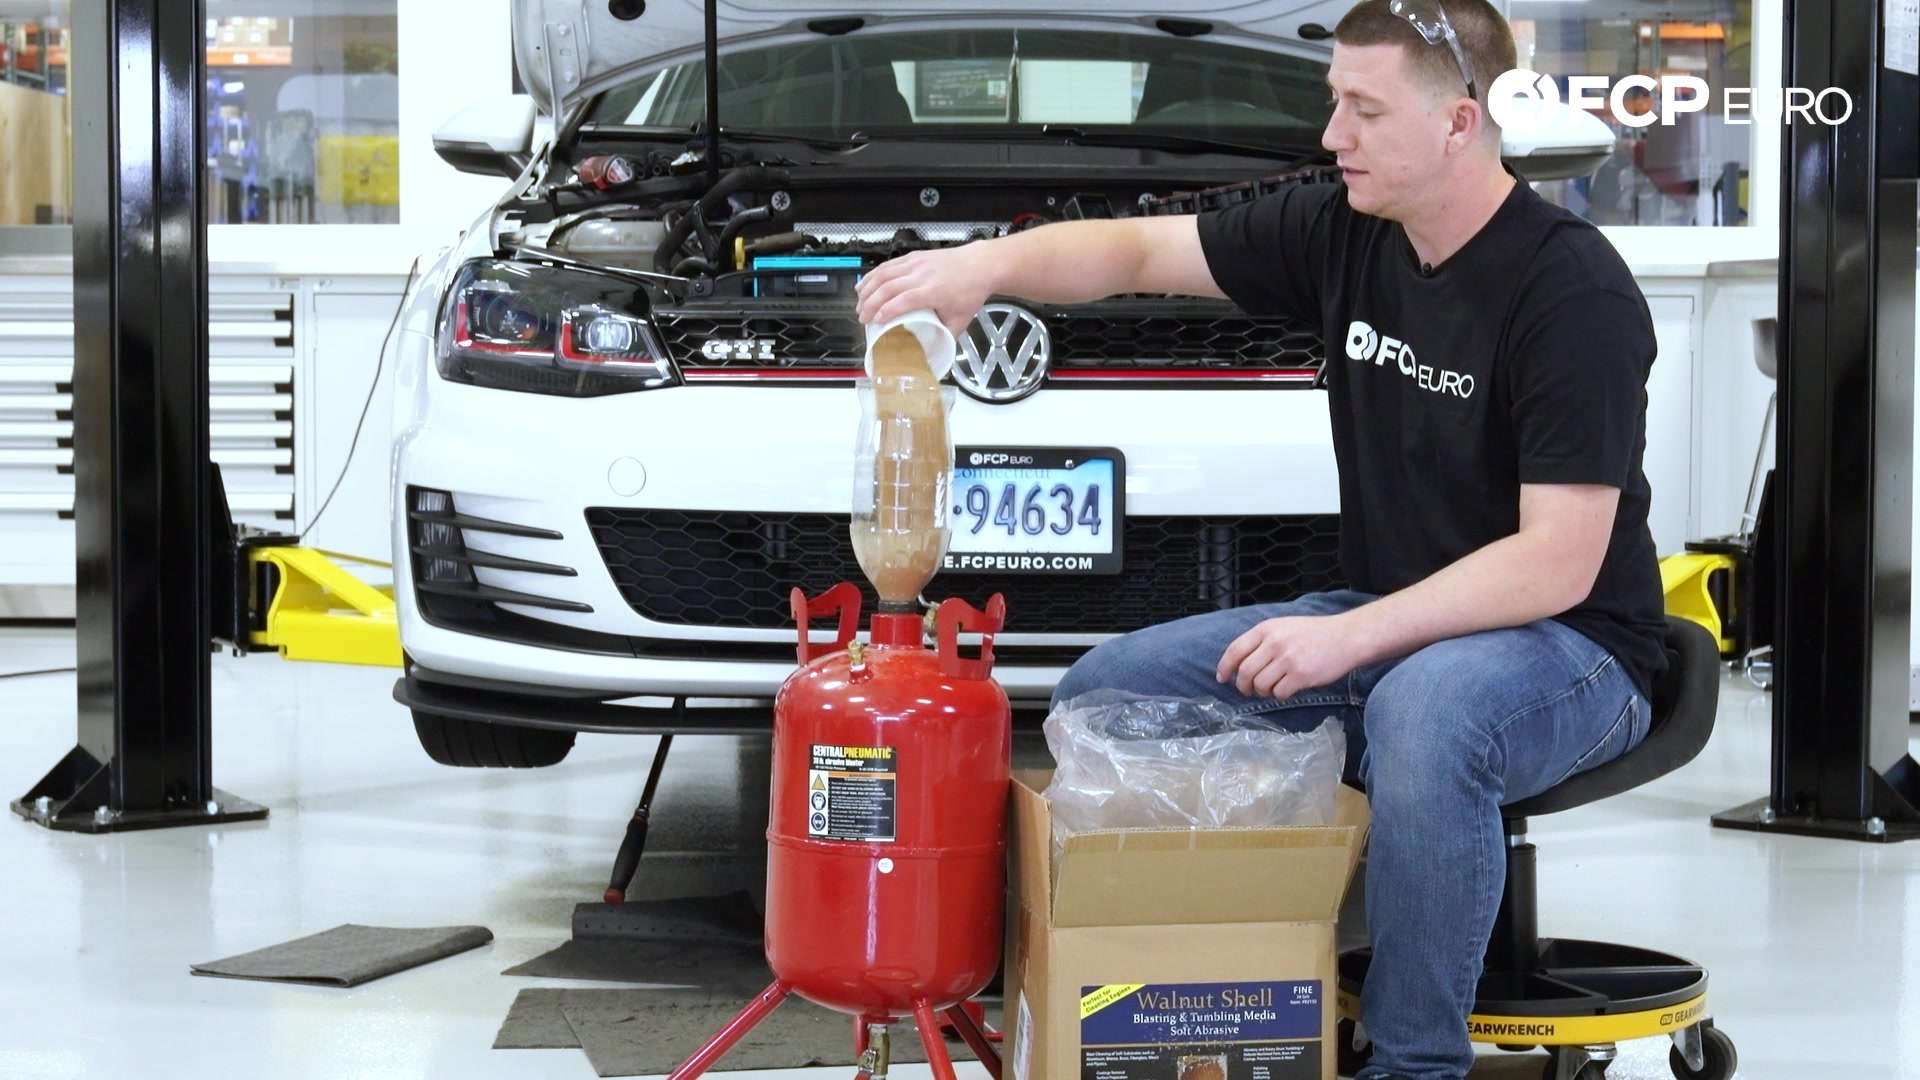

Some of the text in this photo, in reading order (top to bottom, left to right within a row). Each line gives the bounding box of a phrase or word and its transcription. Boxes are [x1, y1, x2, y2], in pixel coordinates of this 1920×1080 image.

[701, 339, 776, 360] GTI
[1375, 335, 1475, 399] FC EURO
[983, 453, 1034, 465] FCP EURO
[943, 555, 1093, 570] E.FCPEURO.COM
[1136, 986, 1273, 1010] Walnut Shell
[1293, 985, 1313, 995] FINE
[1133, 1009, 1276, 1025] Blasting & Tumbling Media
[1170, 1024, 1240, 1036] Soft Abrasive
[1466, 1021, 1555, 1037] EARWRENCH
